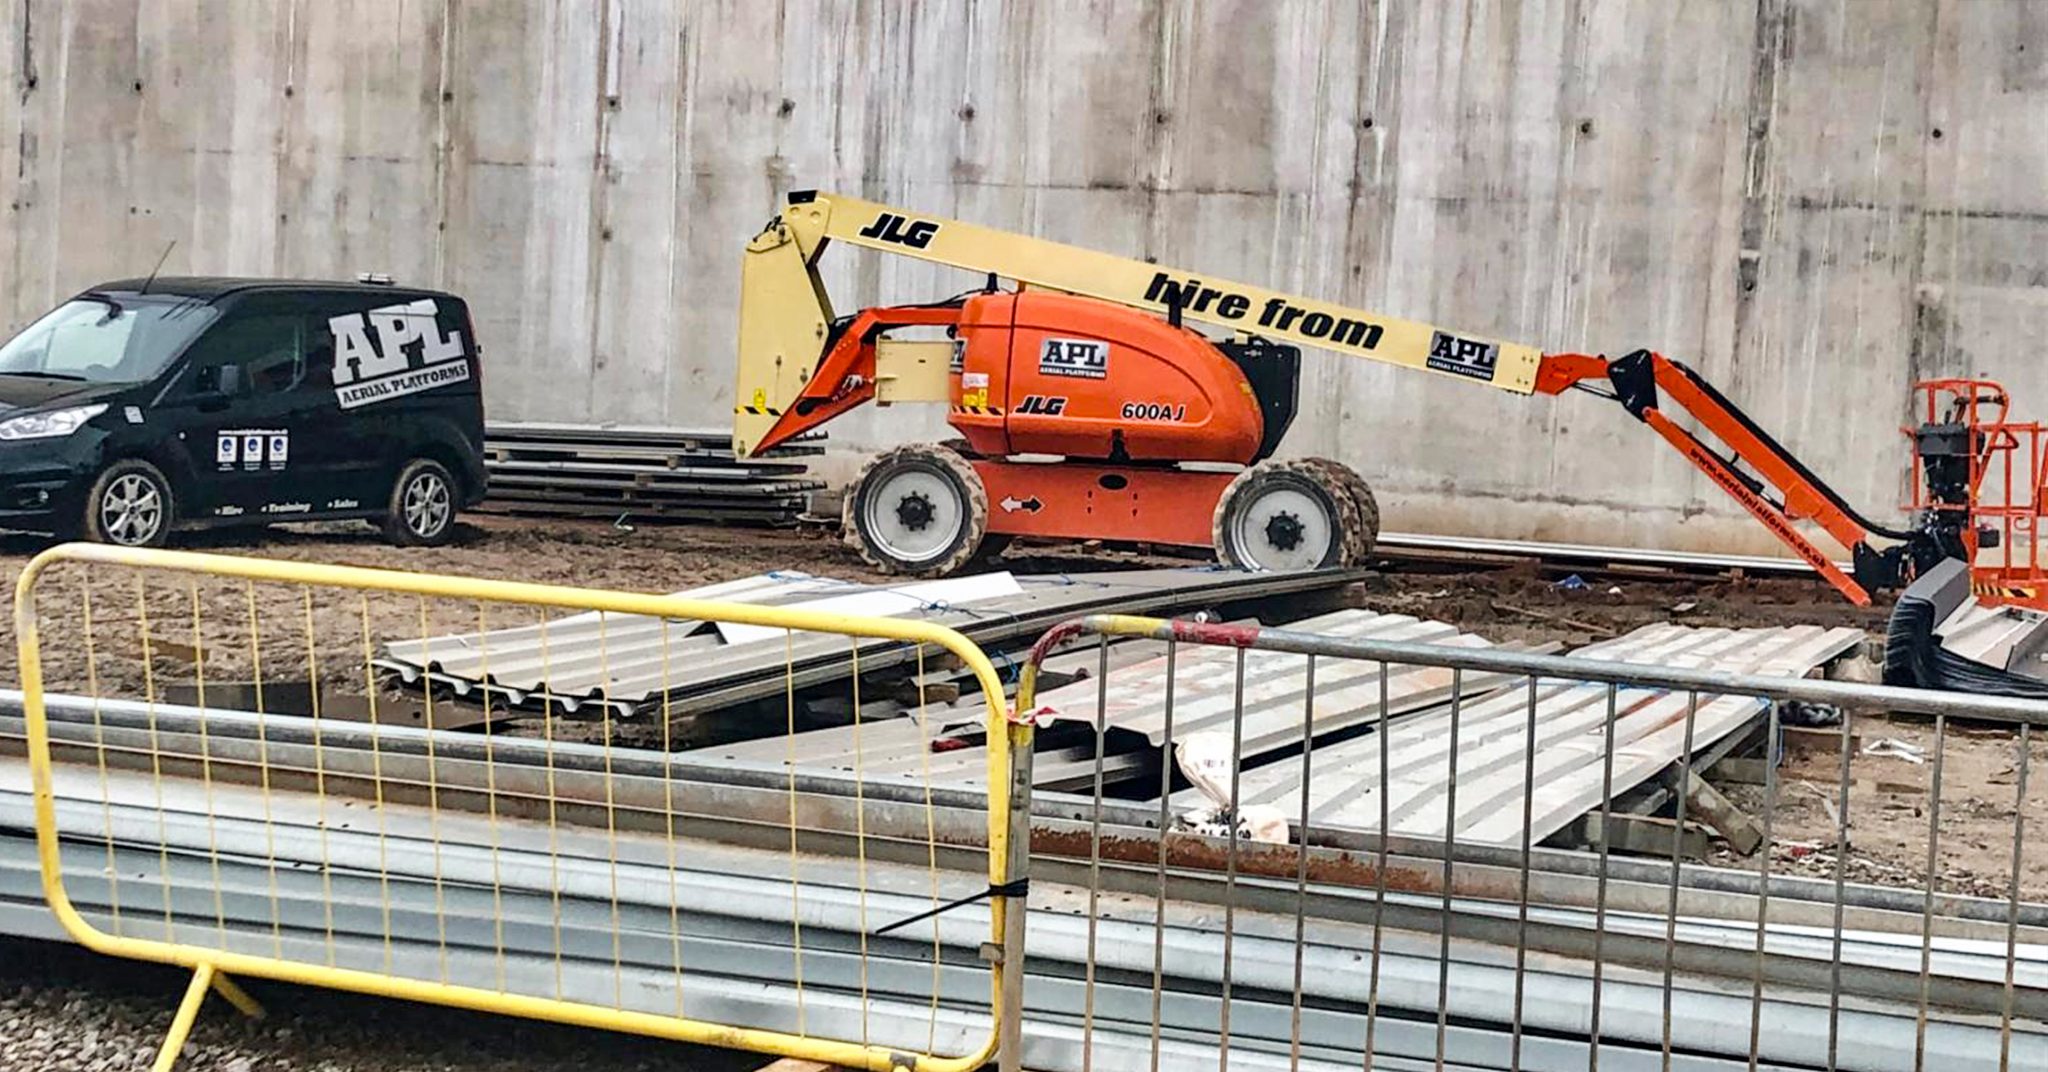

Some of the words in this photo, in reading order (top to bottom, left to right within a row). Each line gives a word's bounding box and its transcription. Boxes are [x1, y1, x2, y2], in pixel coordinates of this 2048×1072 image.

[859, 213, 940, 249] JLG
[1143, 272, 1250, 319] hire
[1257, 298, 1384, 350] from
[328, 298, 465, 385] APL
[1042, 340, 1106, 366] APL
[1432, 333, 1495, 368] APL
[342, 383, 392, 404] AERIAL
[391, 364, 467, 392] PLATFORMS
[1015, 396, 1067, 415] JLG
[1121, 403, 1185, 421] 600AJ
